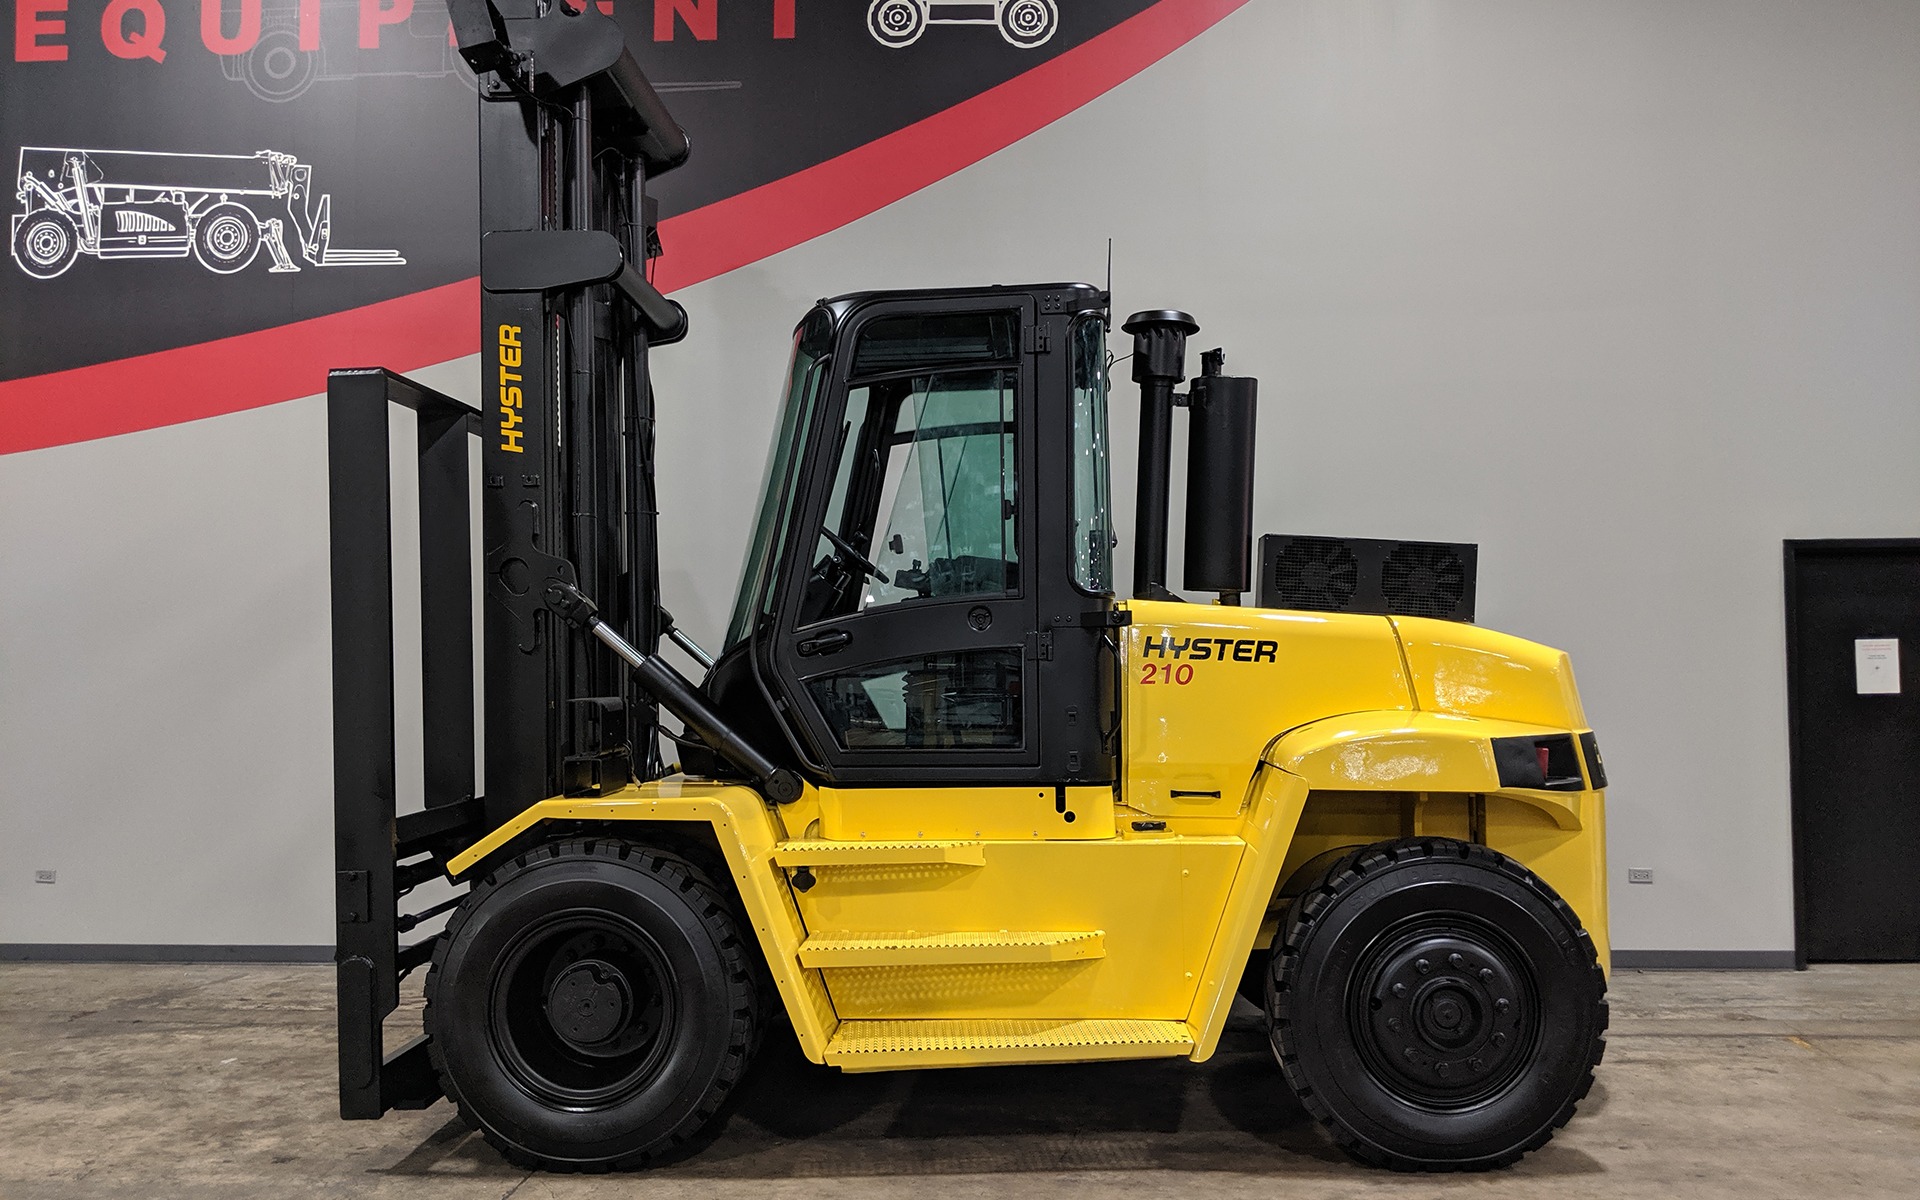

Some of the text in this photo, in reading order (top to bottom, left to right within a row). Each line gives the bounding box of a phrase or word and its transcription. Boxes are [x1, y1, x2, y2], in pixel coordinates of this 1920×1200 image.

[14, 0, 796, 64] EQUIPN
[499, 324, 524, 453] HYSTER
[1142, 636, 1279, 663] HYSTER
[1140, 663, 1194, 686] 210
